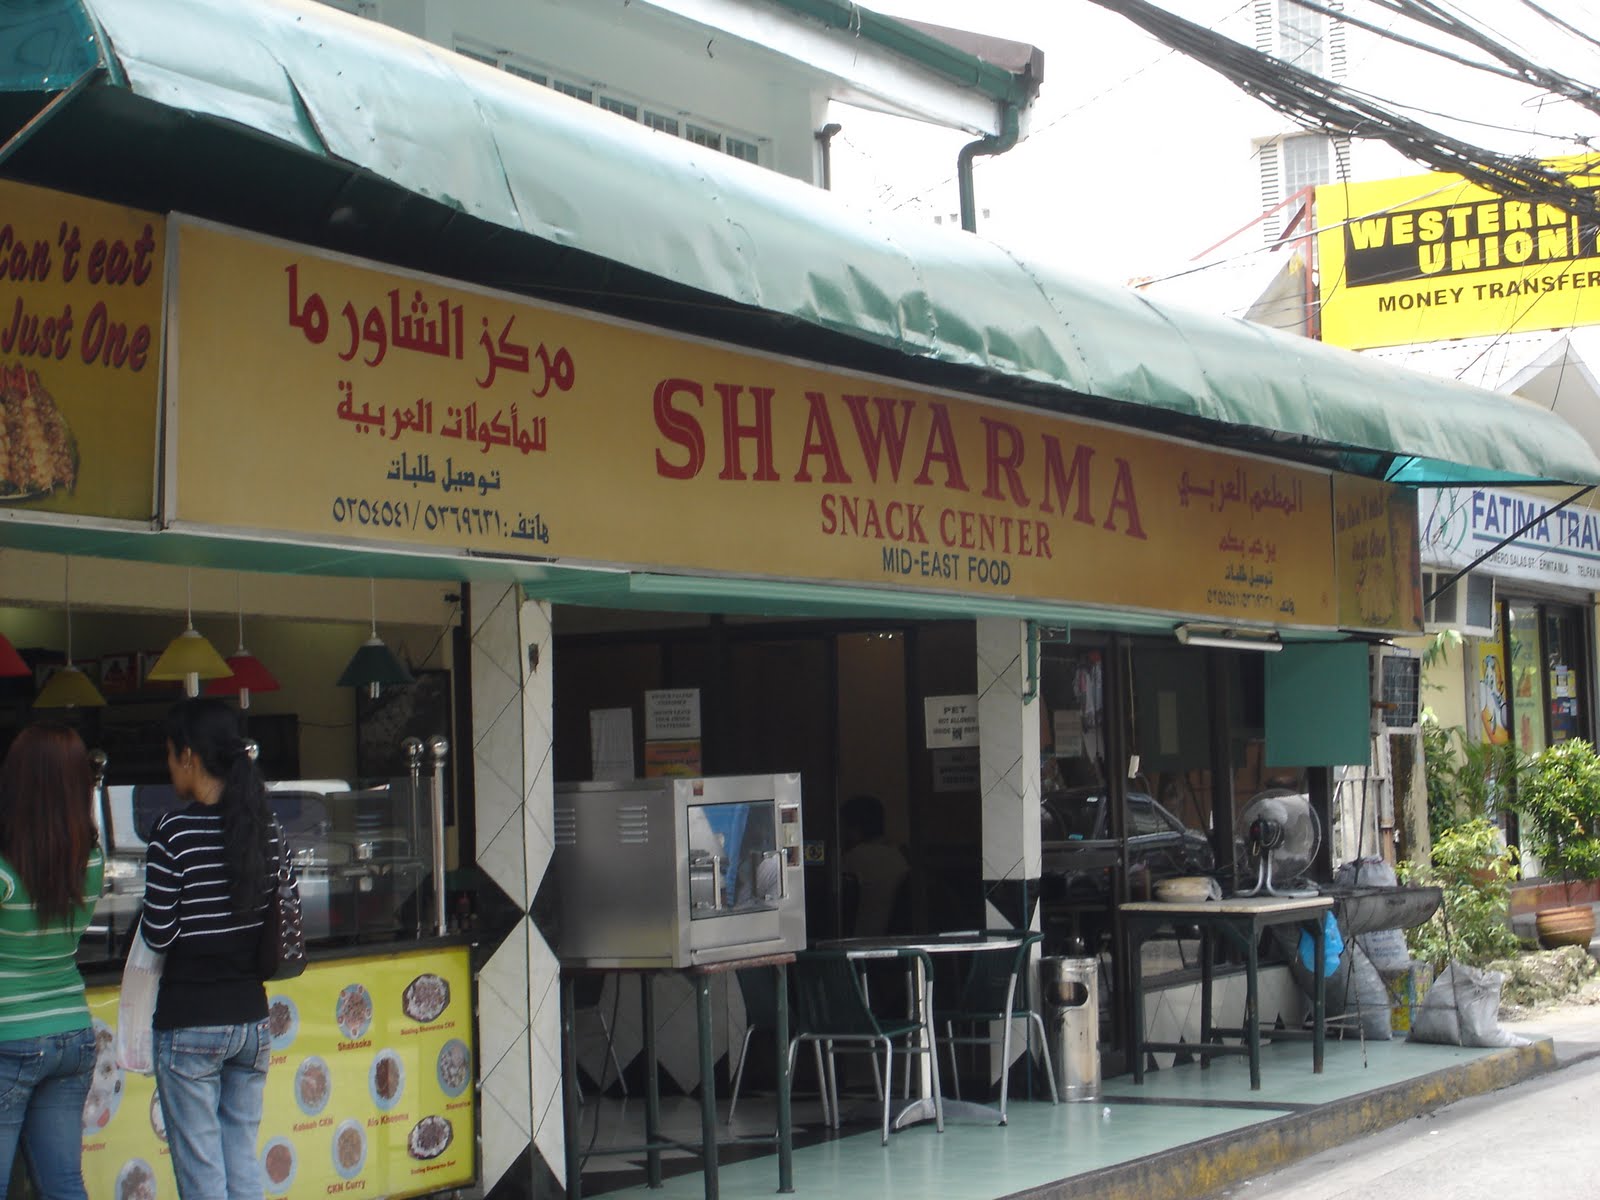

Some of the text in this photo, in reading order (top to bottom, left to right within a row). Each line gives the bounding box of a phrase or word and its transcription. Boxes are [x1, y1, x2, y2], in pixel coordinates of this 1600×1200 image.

[0, 221, 156, 287] Can't eat
[1349, 200, 1567, 251] WESTERN
[1418, 228, 1568, 275] UNION
[1378, 270, 1600, 313] MONEY TRANSFER
[1, 295, 151, 373] Just One
[475, 314, 576, 399] مركز
[336, 379, 547, 455] للمأكولات العربية
[386, 451, 501, 496] توصيل طلبات
[652, 378, 1149, 541] SHAWARMA
[819, 493, 1054, 560] SNACK CENTER
[1472, 490, 1550, 544] FATIMA
[881, 545, 1013, 587] MID-EAST FOOD
